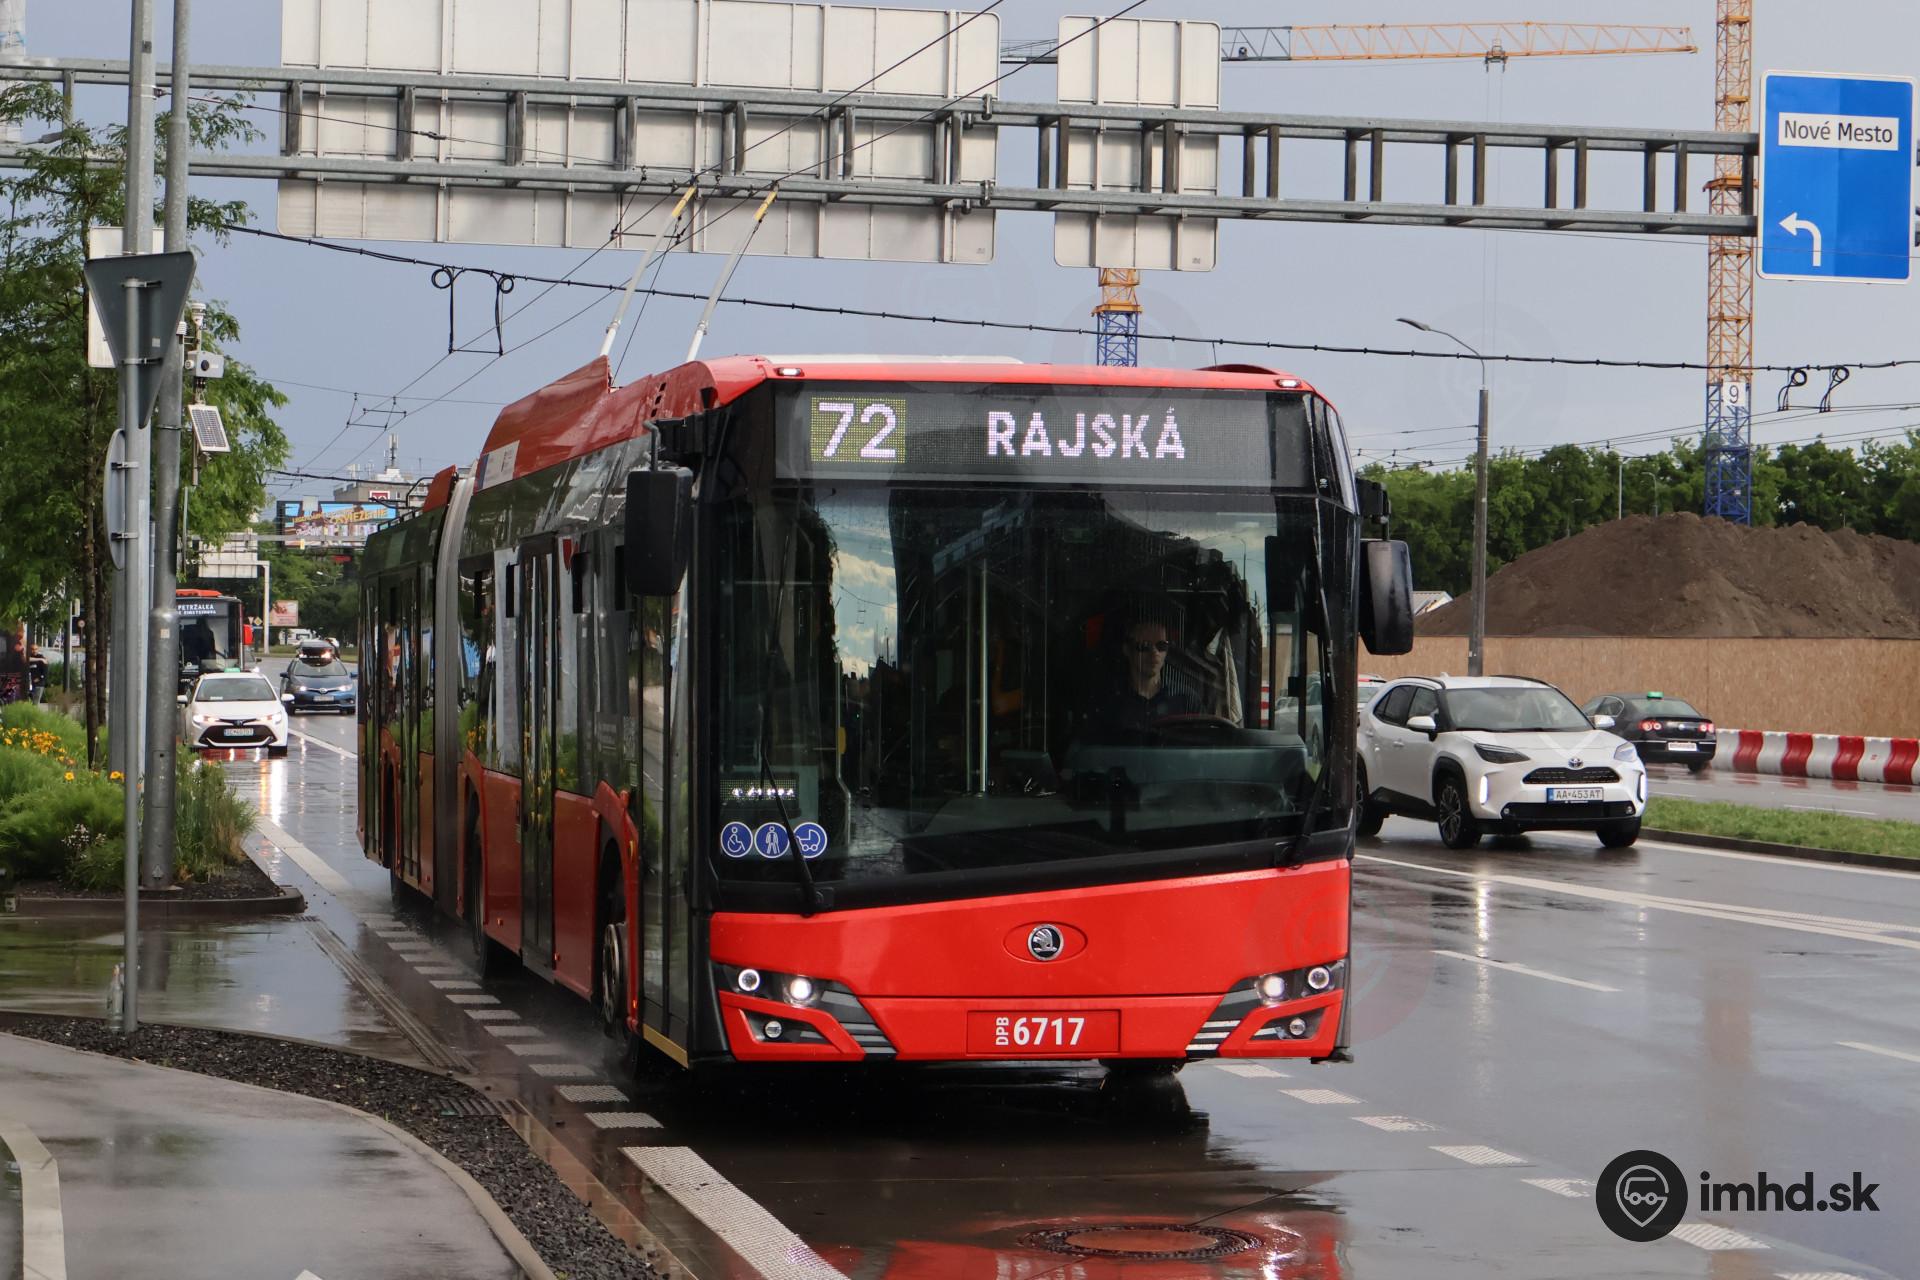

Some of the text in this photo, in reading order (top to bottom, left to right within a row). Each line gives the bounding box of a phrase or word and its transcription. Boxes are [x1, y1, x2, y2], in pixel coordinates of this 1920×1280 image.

[1784, 120, 1893, 143] Nové Mesto
[1729, 385, 1739, 404] 9
[819, 402, 1185, 459] 72 RAJSKÁ
[995, 1017, 1009, 1045] DPB
[1013, 1017, 1085, 1046] 6717
